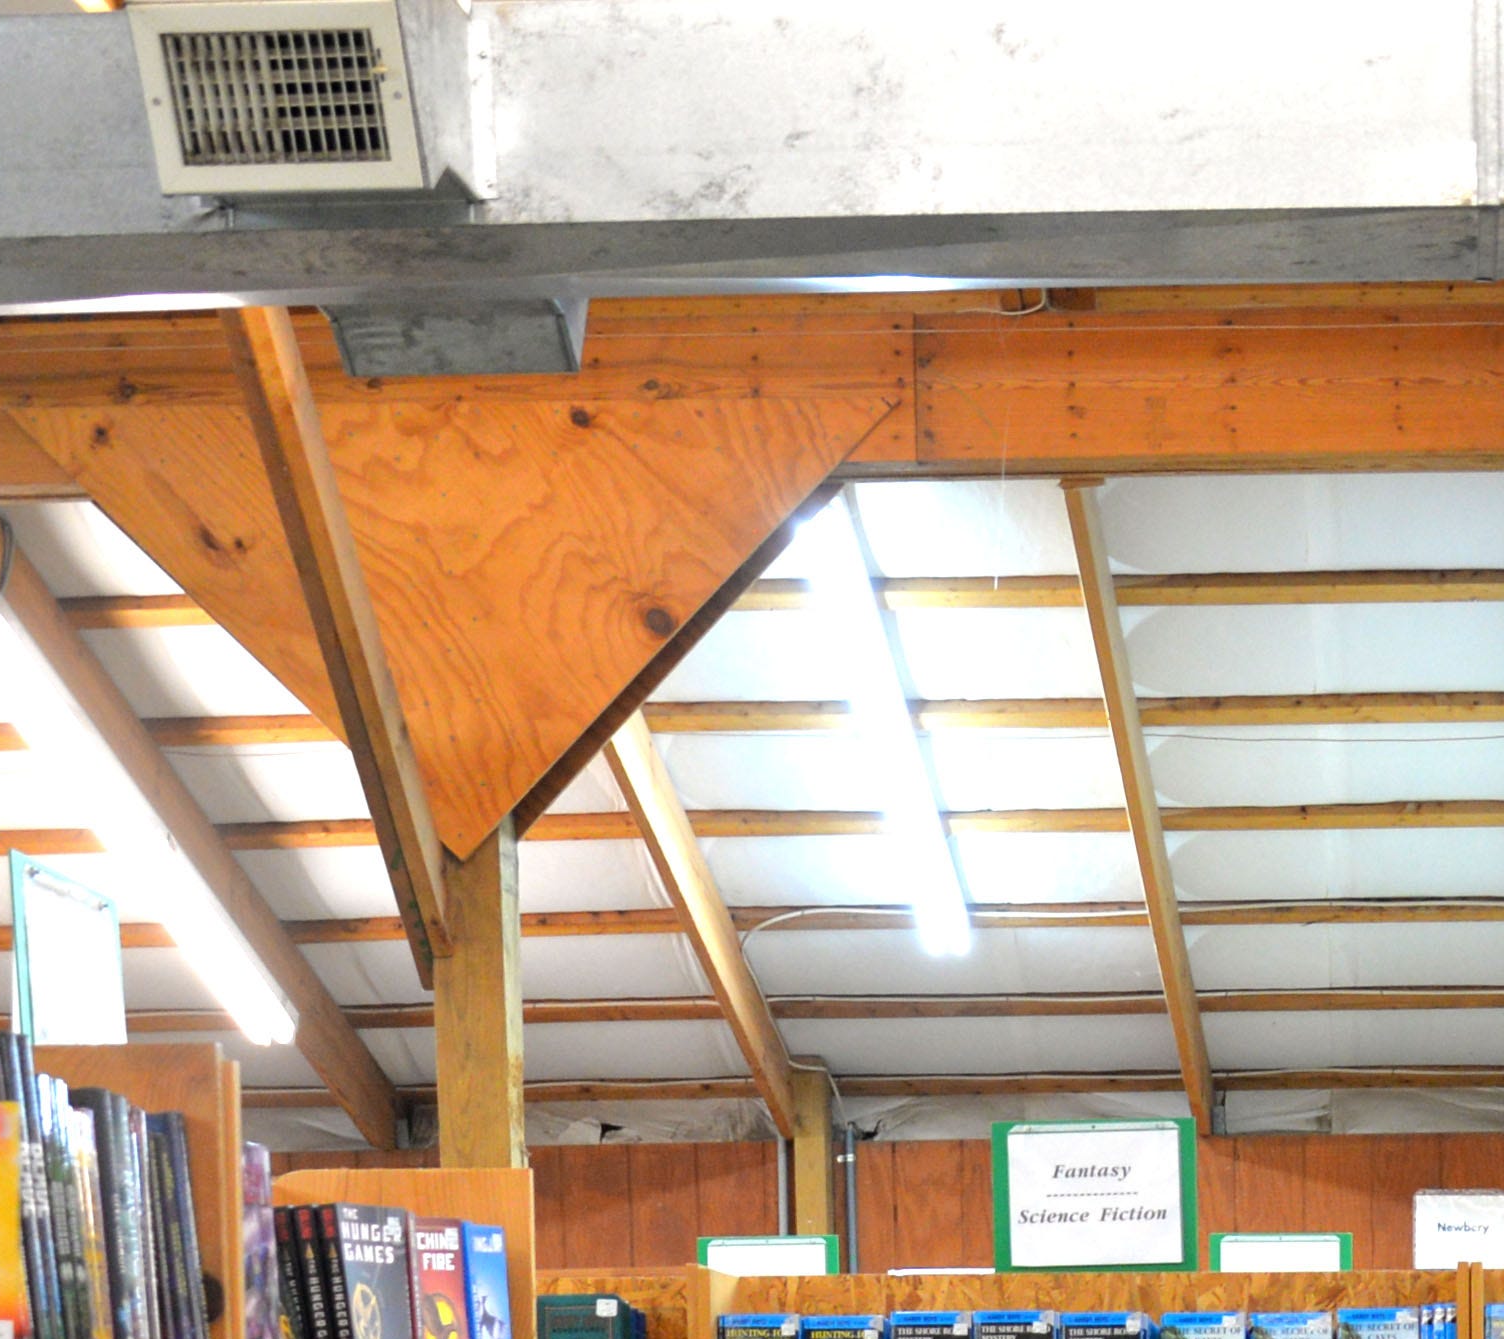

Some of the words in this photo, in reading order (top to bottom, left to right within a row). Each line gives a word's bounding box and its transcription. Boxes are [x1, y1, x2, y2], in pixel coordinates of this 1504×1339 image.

[1052, 1164, 1132, 1182] Fantasy
[342, 1207, 359, 1220] THE
[1017, 1208, 1090, 1225] Science
[1099, 1206, 1168, 1222] Fiction
[340, 1220, 402, 1243] HUNGER
[1437, 1221, 1490, 1236] Newbery
[343, 1243, 395, 1264] GAMES
[422, 1253, 456, 1271] FIRE
[309, 1276, 327, 1328] HUNGER
[332, 1276, 349, 1328] HUNGER
